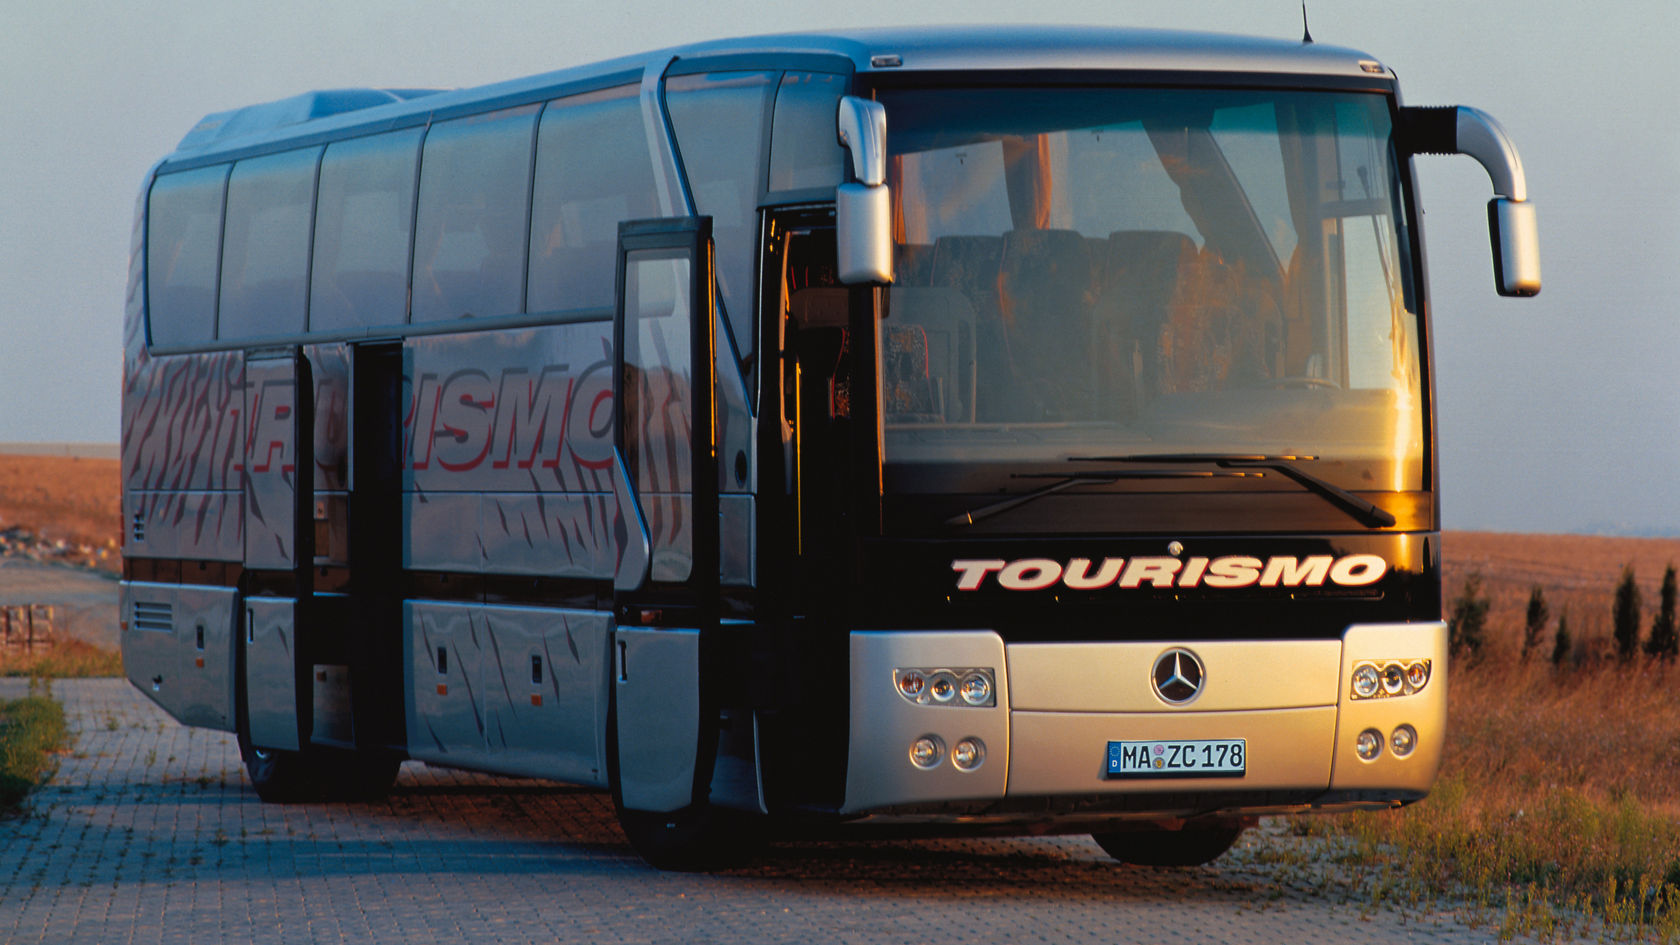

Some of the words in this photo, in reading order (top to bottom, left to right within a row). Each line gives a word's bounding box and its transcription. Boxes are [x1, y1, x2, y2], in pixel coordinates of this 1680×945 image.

[951, 554, 1387, 591] TOURISMO
[1111, 760, 1118, 768] D
[1122, 746, 1151, 768] MA
[1167, 745, 1196, 768] ZC
[1202, 744, 1242, 767] 178
